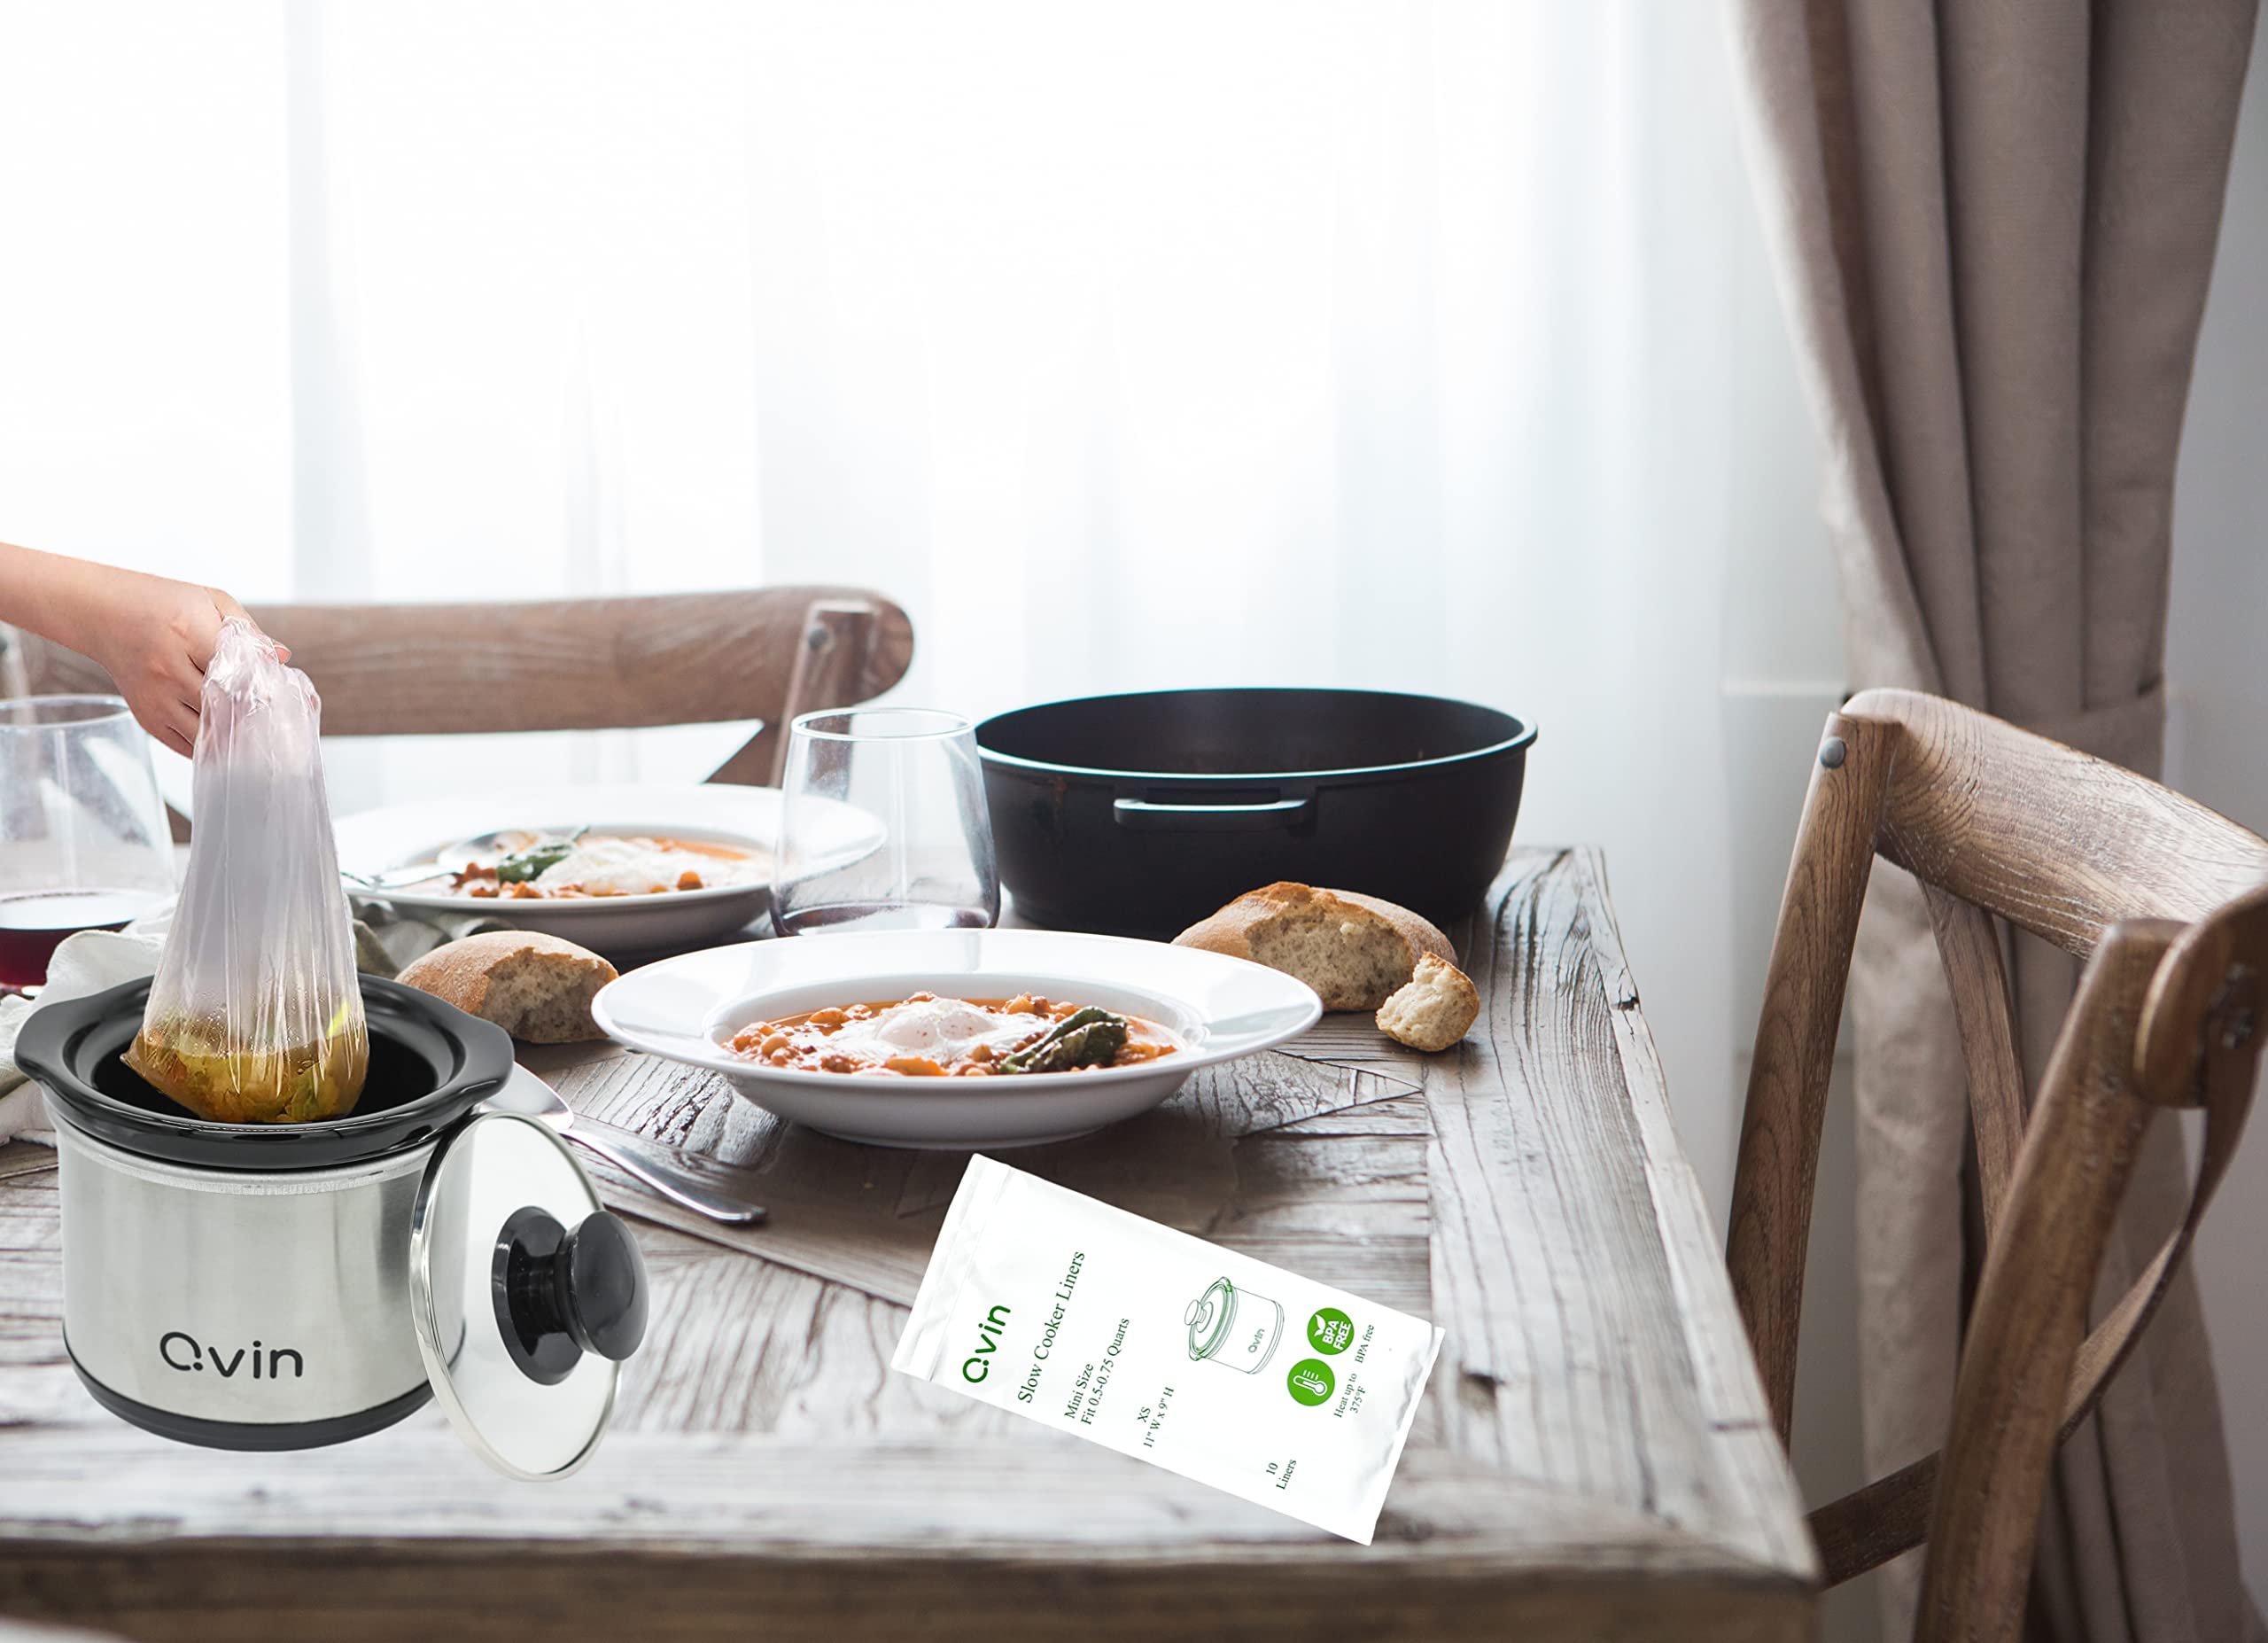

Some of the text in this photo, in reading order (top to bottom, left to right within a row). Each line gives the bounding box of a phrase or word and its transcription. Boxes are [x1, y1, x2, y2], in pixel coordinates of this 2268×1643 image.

[963, 1305, 1011, 1382] Qvin
[1018, 1251, 1085, 1403] Slow Cooker Liners
[1323, 1320, 1340, 1344] BPA
[1333, 1321, 1351, 1351] FREE
[1355, 1324, 1375, 1365] BPA free
[159, 1331, 304, 1380] Qvin
[1080, 1318, 1130, 1425] Fit 0.5-0.75 Quarts
[1064, 1363, 1094, 1419] Mini Size
[1149, 1419, 1161, 1429] W
[1163, 1387, 1175, 1398] H
[1333, 1373, 1357, 1418] Heat up to
[1137, 1406, 1151, 1423] XS
[1266, 1462, 1278, 1476] 10
[1276, 1459, 1297, 1490] Liners
